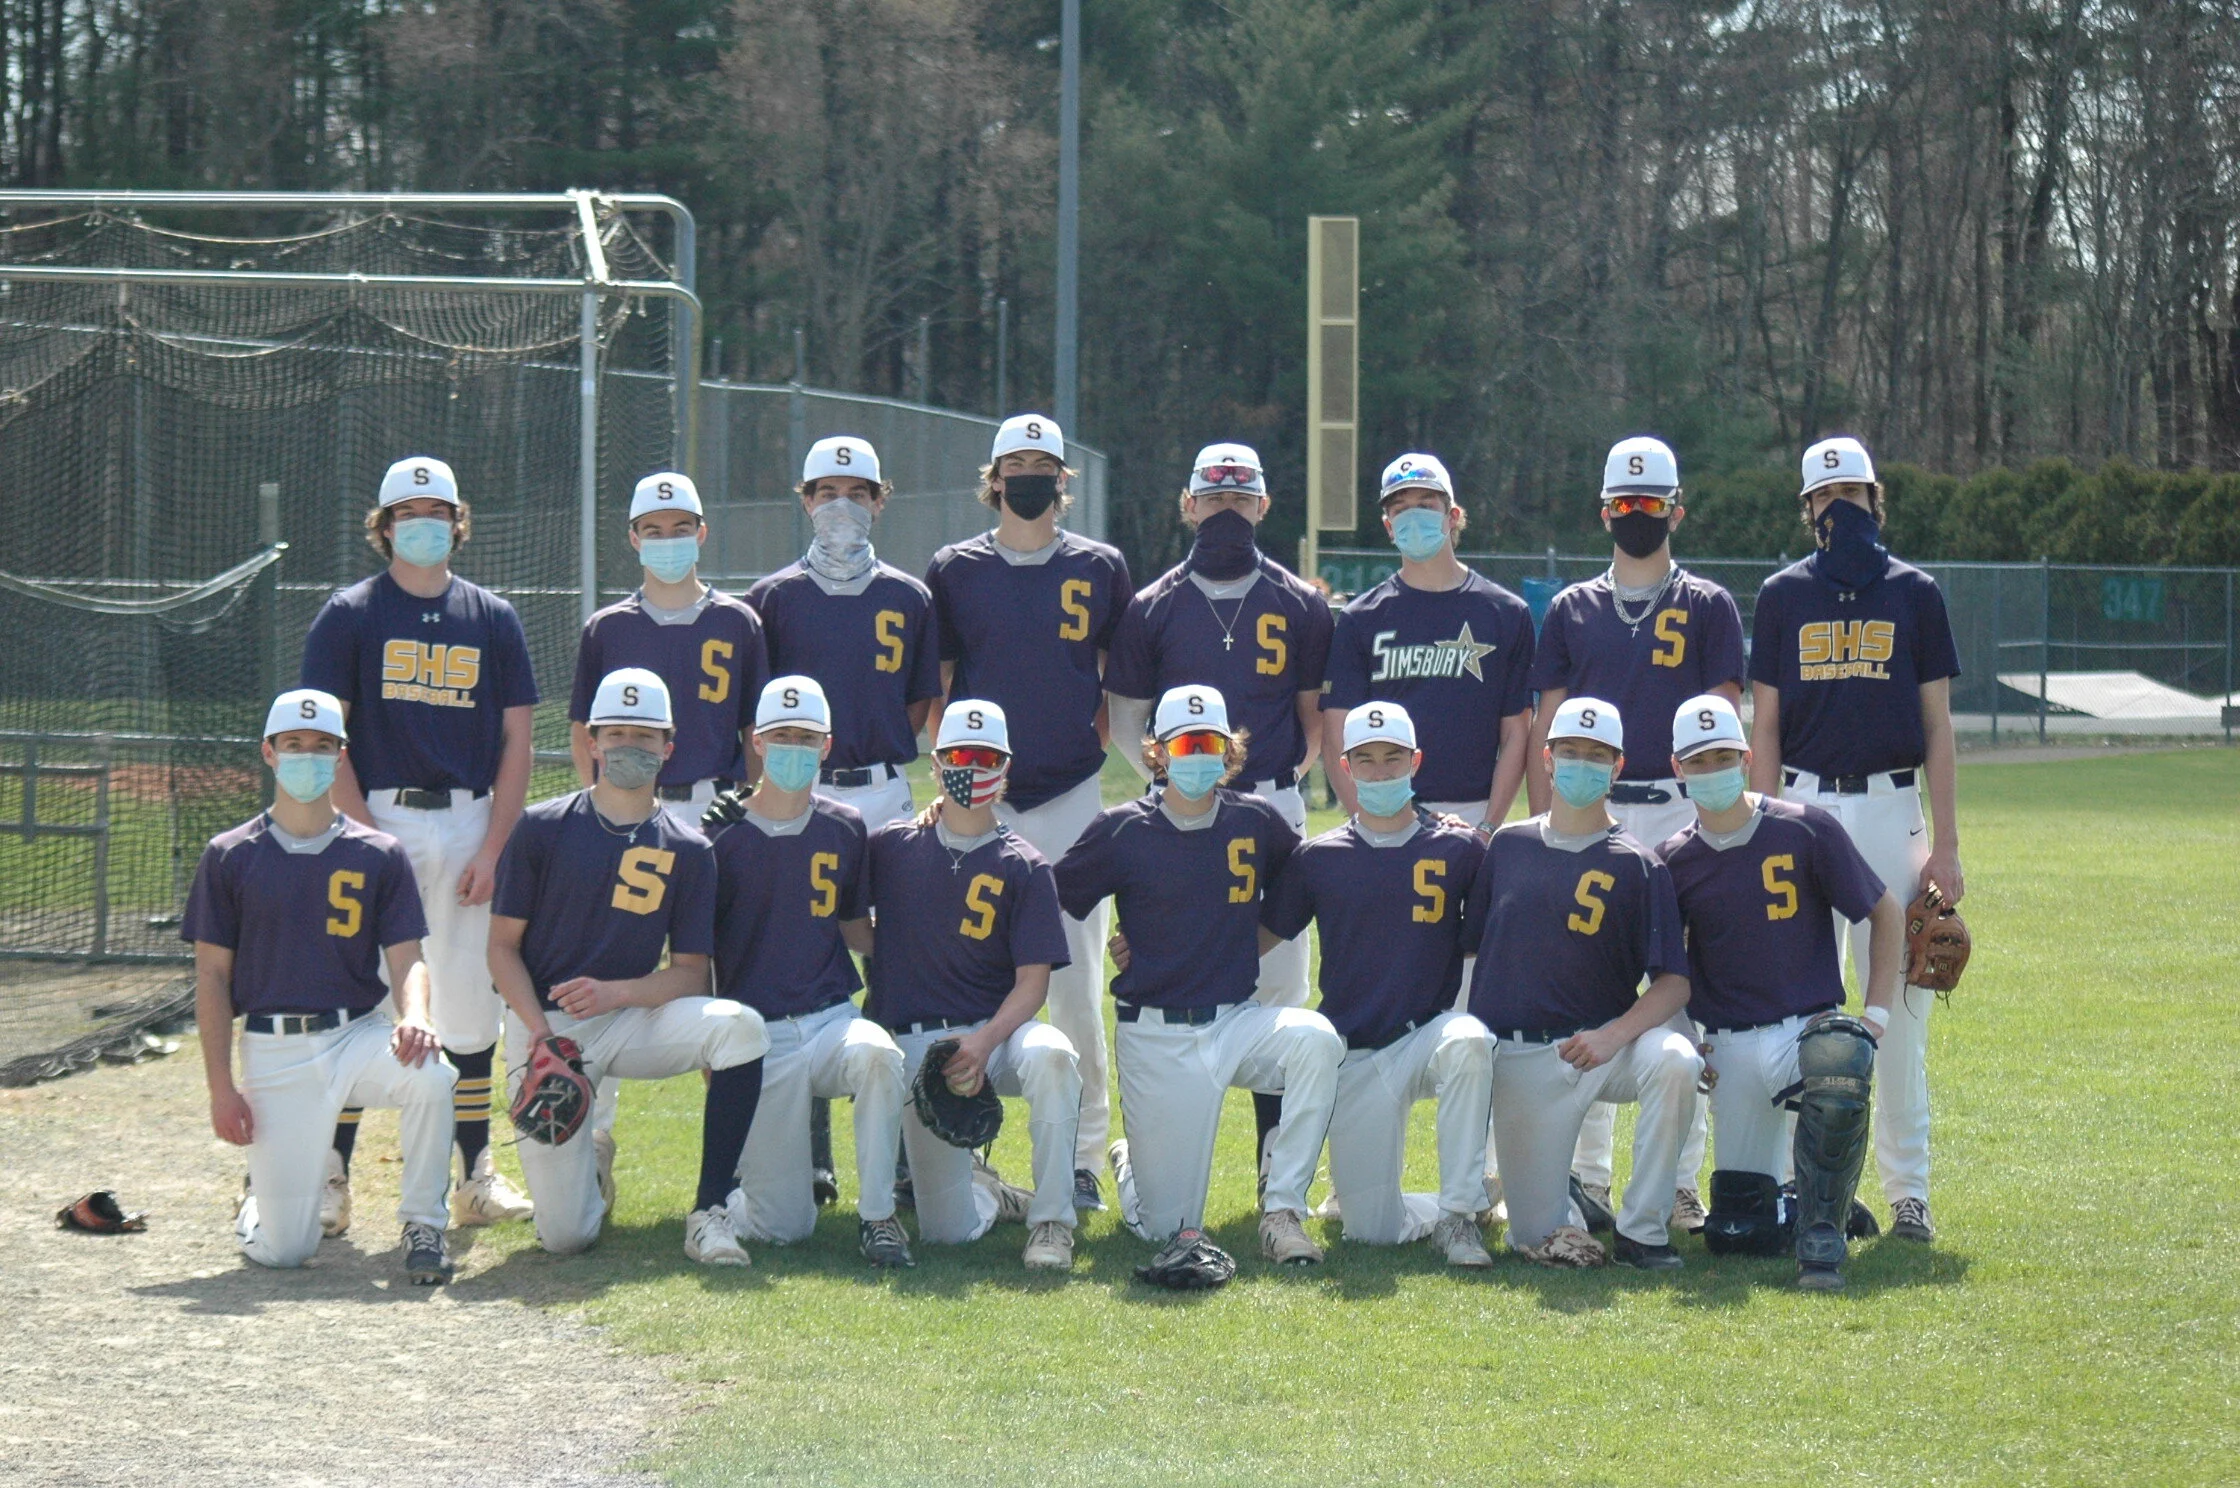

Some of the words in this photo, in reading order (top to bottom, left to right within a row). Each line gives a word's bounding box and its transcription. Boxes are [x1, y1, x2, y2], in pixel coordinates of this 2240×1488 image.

[1026, 422, 1042, 440] S
[414, 467, 430, 486] S
[836, 447, 852, 466] S
[1628, 455, 1644, 476] S
[1823, 450, 1840, 470] S
[657, 482, 674, 501] S
[1060, 579, 1091, 641] S
[2103, 579, 2162, 620] 347
[876, 610, 905, 672] S
[1256, 613, 1287, 676] S
[1370, 630, 1470, 683] SIMSBURY
[1653, 608, 1688, 668] S
[1799, 620, 1895, 663] SHS
[382, 638, 481, 690] SHS
[700, 639, 733, 703] S
[1800, 662, 1890, 681] BASEBALL
[300, 699, 317, 720] S
[382, 682, 476, 708] BASEBALL
[622, 686, 639, 707] S
[782, 688, 799, 709] S
[1188, 695, 1204, 715] S
[967, 711, 984, 730] S
[1368, 710, 1384, 729] S
[1579, 709, 1597, 729] S
[1698, 709, 1716, 731] S
[614, 847, 675, 915] S
[811, 852, 838, 917] S
[1227, 838, 1256, 903] S
[1413, 858, 1446, 923] S
[1762, 854, 1798, 921] S
[327, 870, 365, 937] S
[960, 873, 1005, 940] S
[1567, 871, 1615, 935] S
